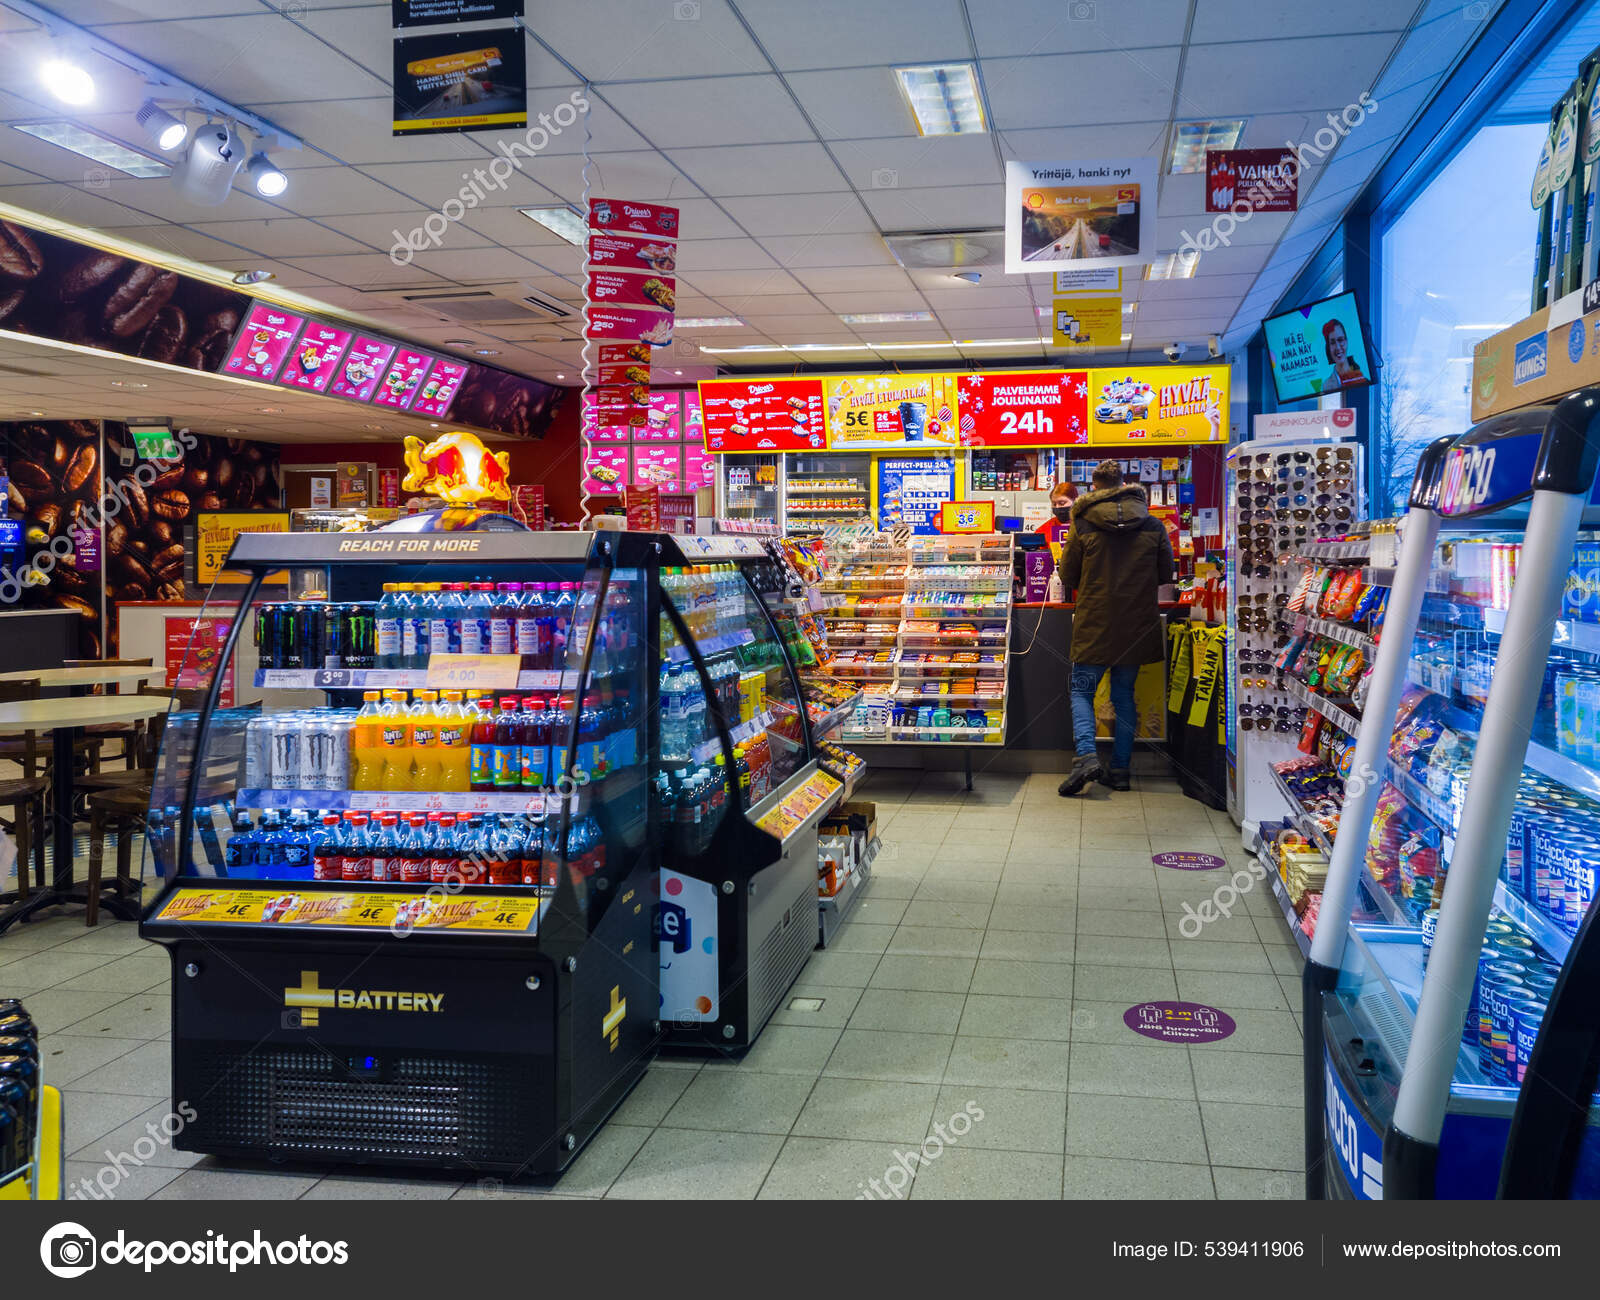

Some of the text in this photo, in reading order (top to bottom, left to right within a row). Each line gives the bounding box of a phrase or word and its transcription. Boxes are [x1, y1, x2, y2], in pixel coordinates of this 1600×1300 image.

[409, 4, 495, 17] turvallisuuden hallintaan
[416, 66, 488, 85] HANKI SHELL CARD
[1032, 167, 1132, 180] Yrittäjä, hanki nyt
[1238, 165, 1292, 179] VAIHDA
[1281, 348, 1298, 360] AINA
[1515, 352, 1546, 378] KUNGS
[993, 385, 1059, 396] PALVELEMME
[1159, 374, 1212, 408] HYVÄÄ
[991, 395, 1062, 406] JOULUNAKIN
[845, 411, 869, 427] 5€
[876, 413, 889, 422] 2€
[1000, 409, 1053, 434] 24h
[1270, 416, 1329, 428] AURINKOLASIT
[338, 539, 482, 553] REACH FOR MORE
[447, 670, 475, 681] 4.00
[1195, 649, 1218, 702] TÄNÄÄN
[383, 730, 403, 741] FANTA
[414, 730, 434, 740] FANTA
[439, 730, 461, 741] FANTA
[425, 801, 442, 809] 4.50
[225, 905, 251, 916] 4€
[359, 908, 383, 919] 4€
[494, 913, 518, 924] 4€
[338, 989, 444, 1012] BATTERY
[1166, 1025, 1223, 1034] turvaväli.
